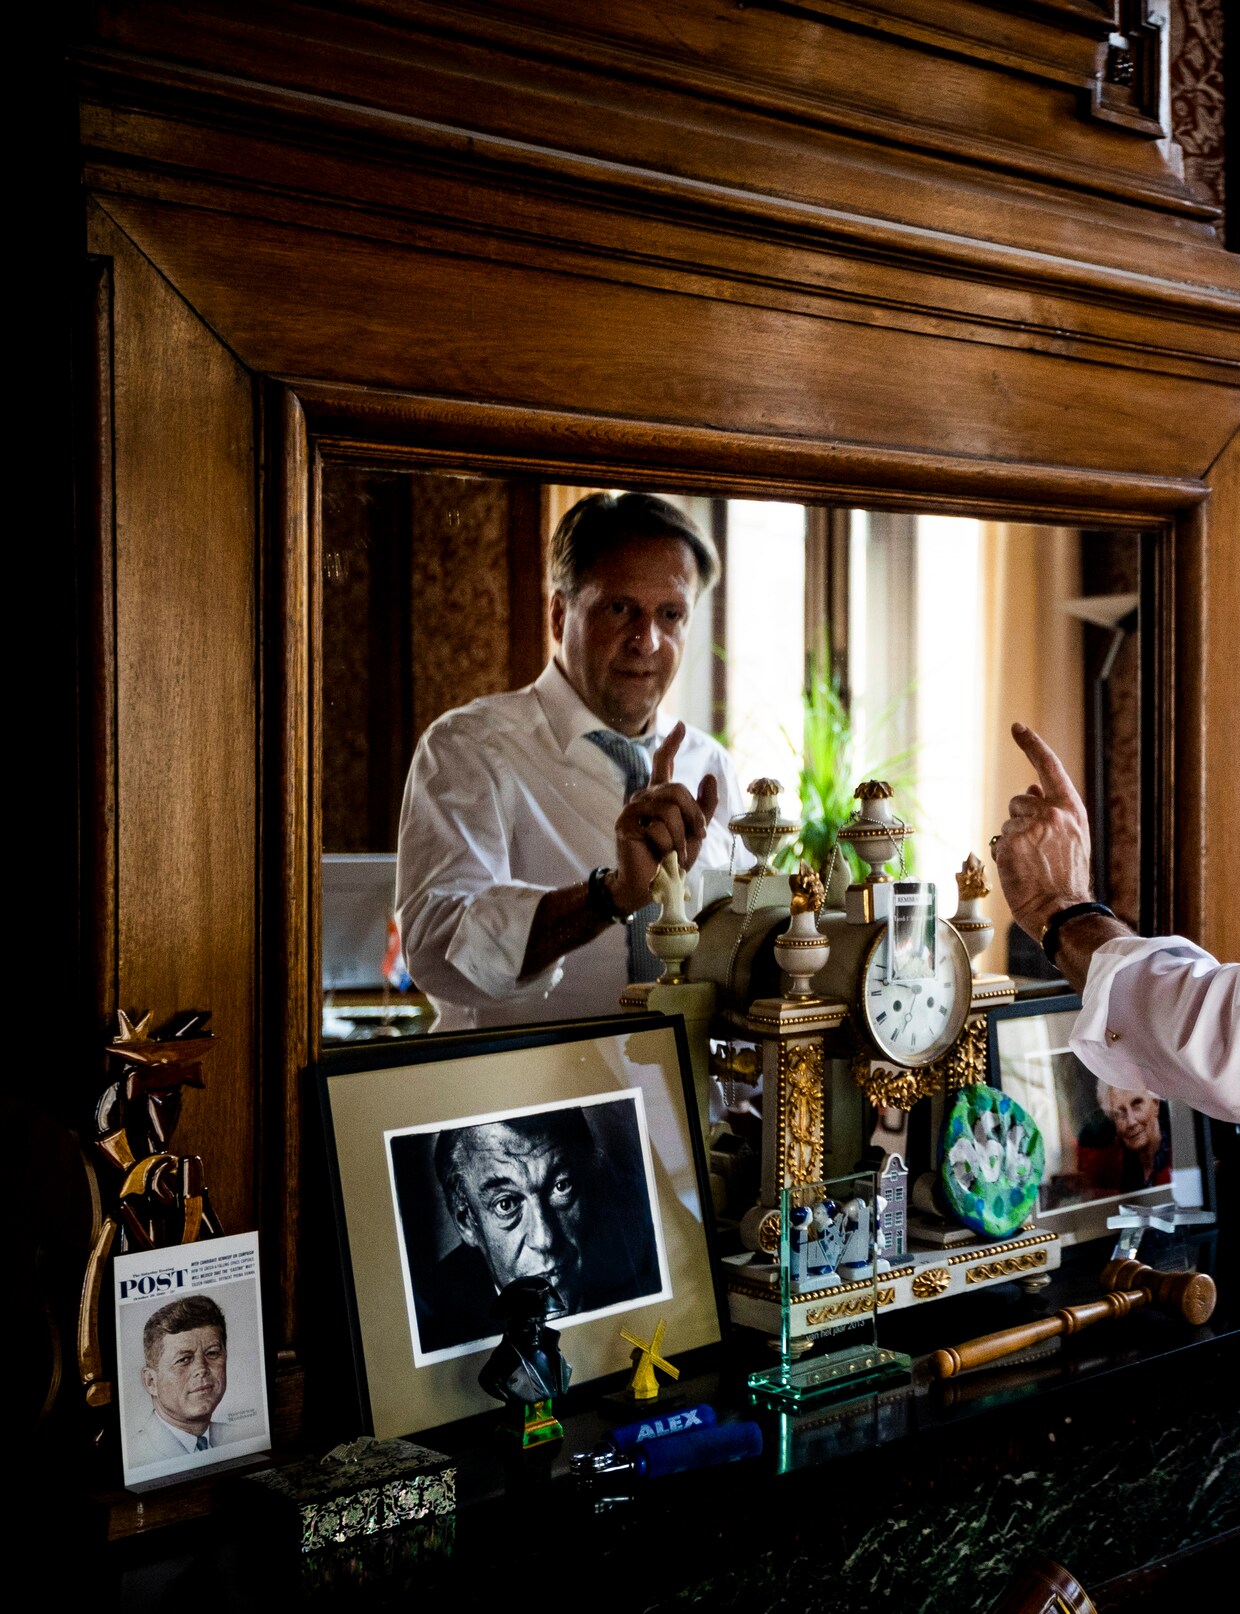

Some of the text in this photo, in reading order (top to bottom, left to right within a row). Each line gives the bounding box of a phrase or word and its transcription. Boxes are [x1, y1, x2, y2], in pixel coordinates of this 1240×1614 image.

[118, 1268, 188, 1299] POST
[805, 1332, 820, 1342] van
[820, 1327, 832, 1338] het
[635, 1408, 703, 1443] ALEX
